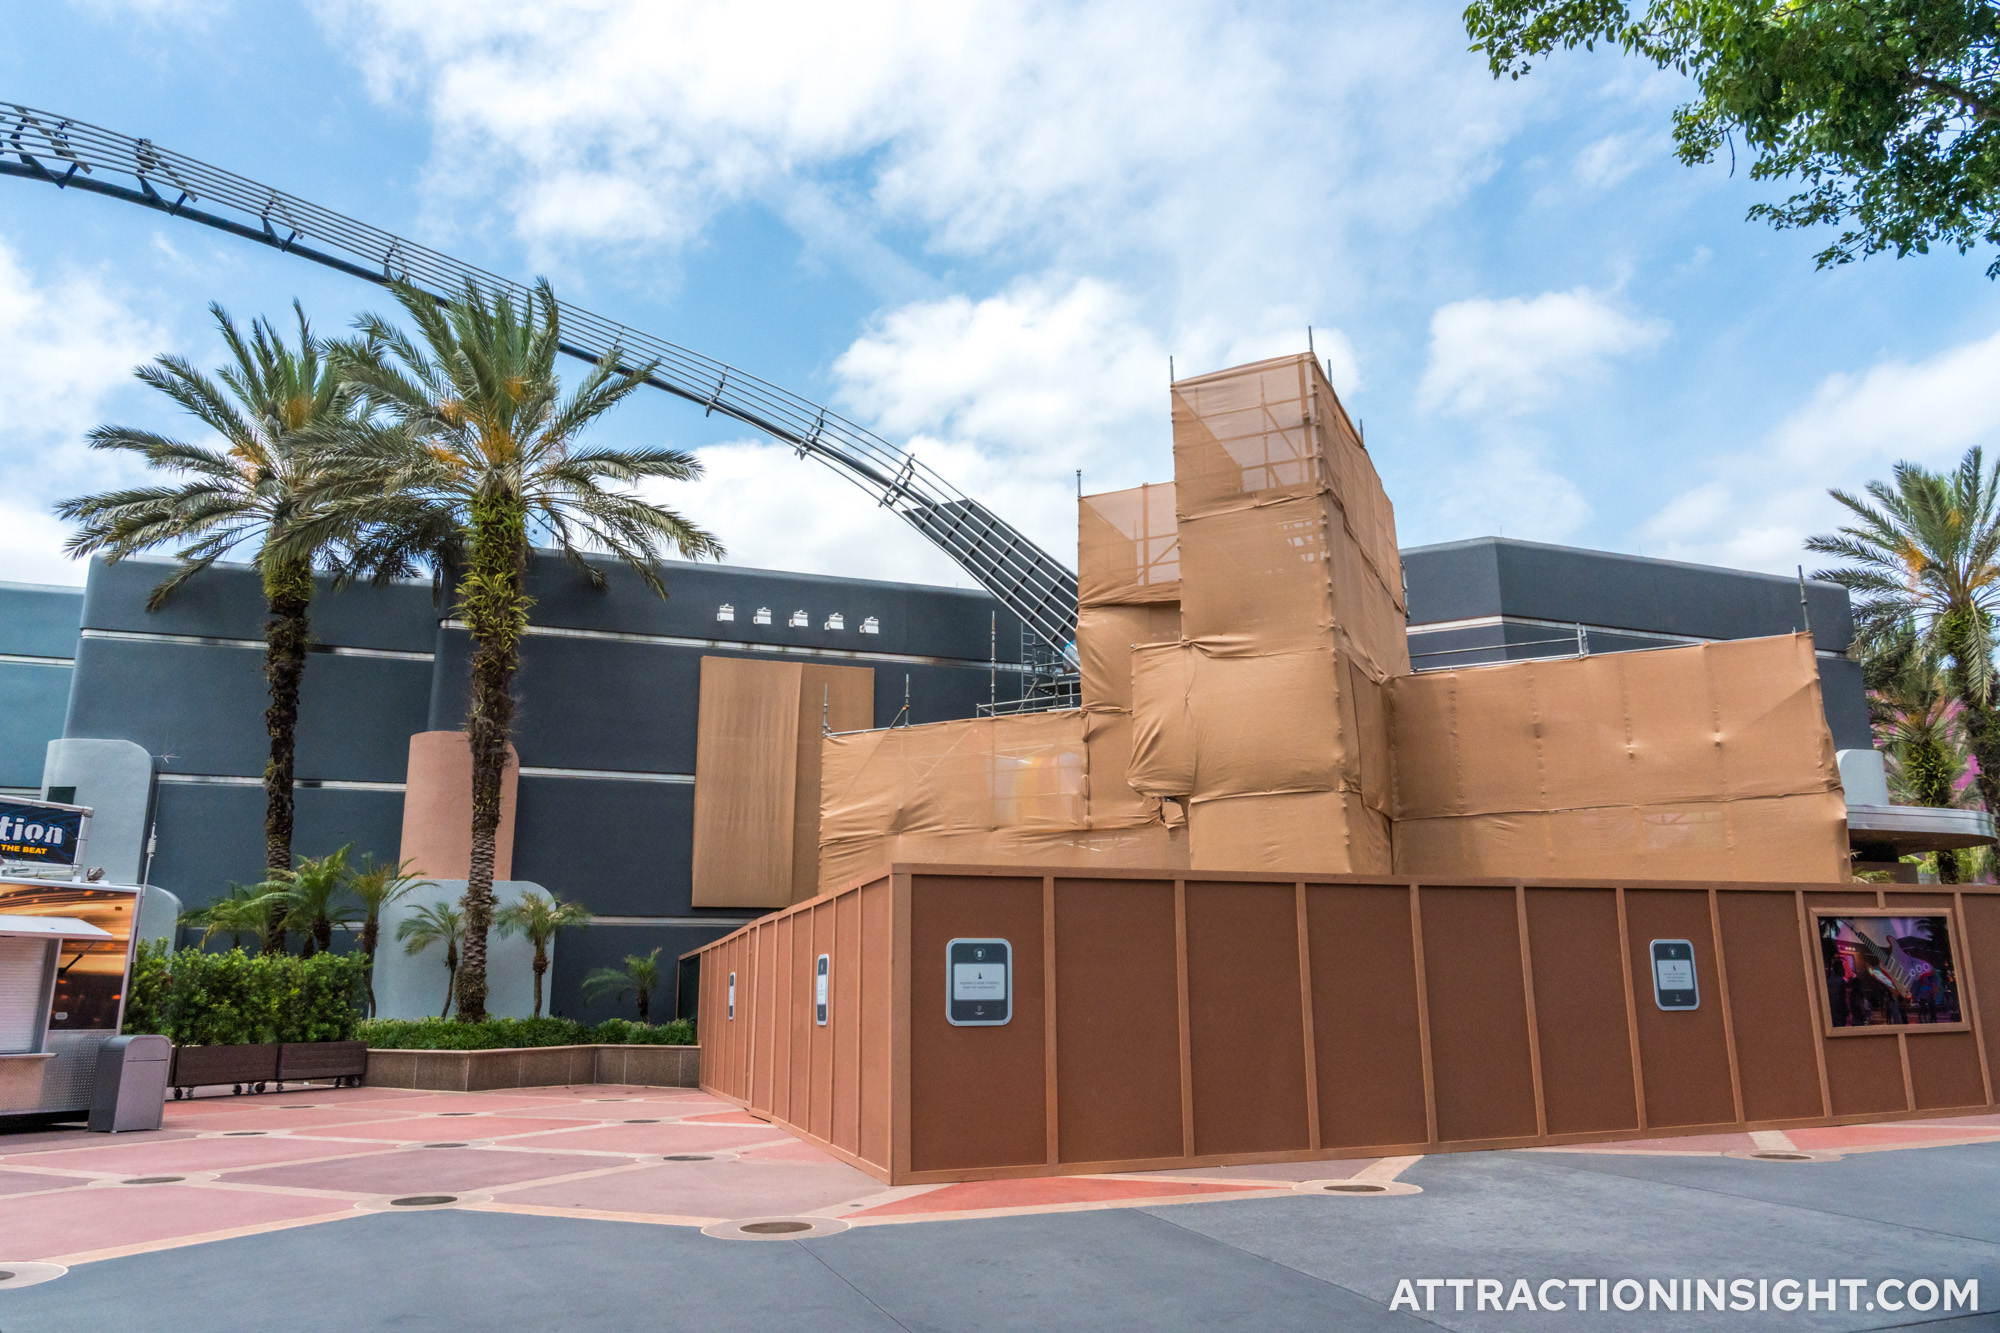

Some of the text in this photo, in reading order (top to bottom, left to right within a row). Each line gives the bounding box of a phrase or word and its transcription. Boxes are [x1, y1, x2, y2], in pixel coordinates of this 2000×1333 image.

[0, 815, 63, 845] tion
[1, 844, 48, 855] THE BEAT
